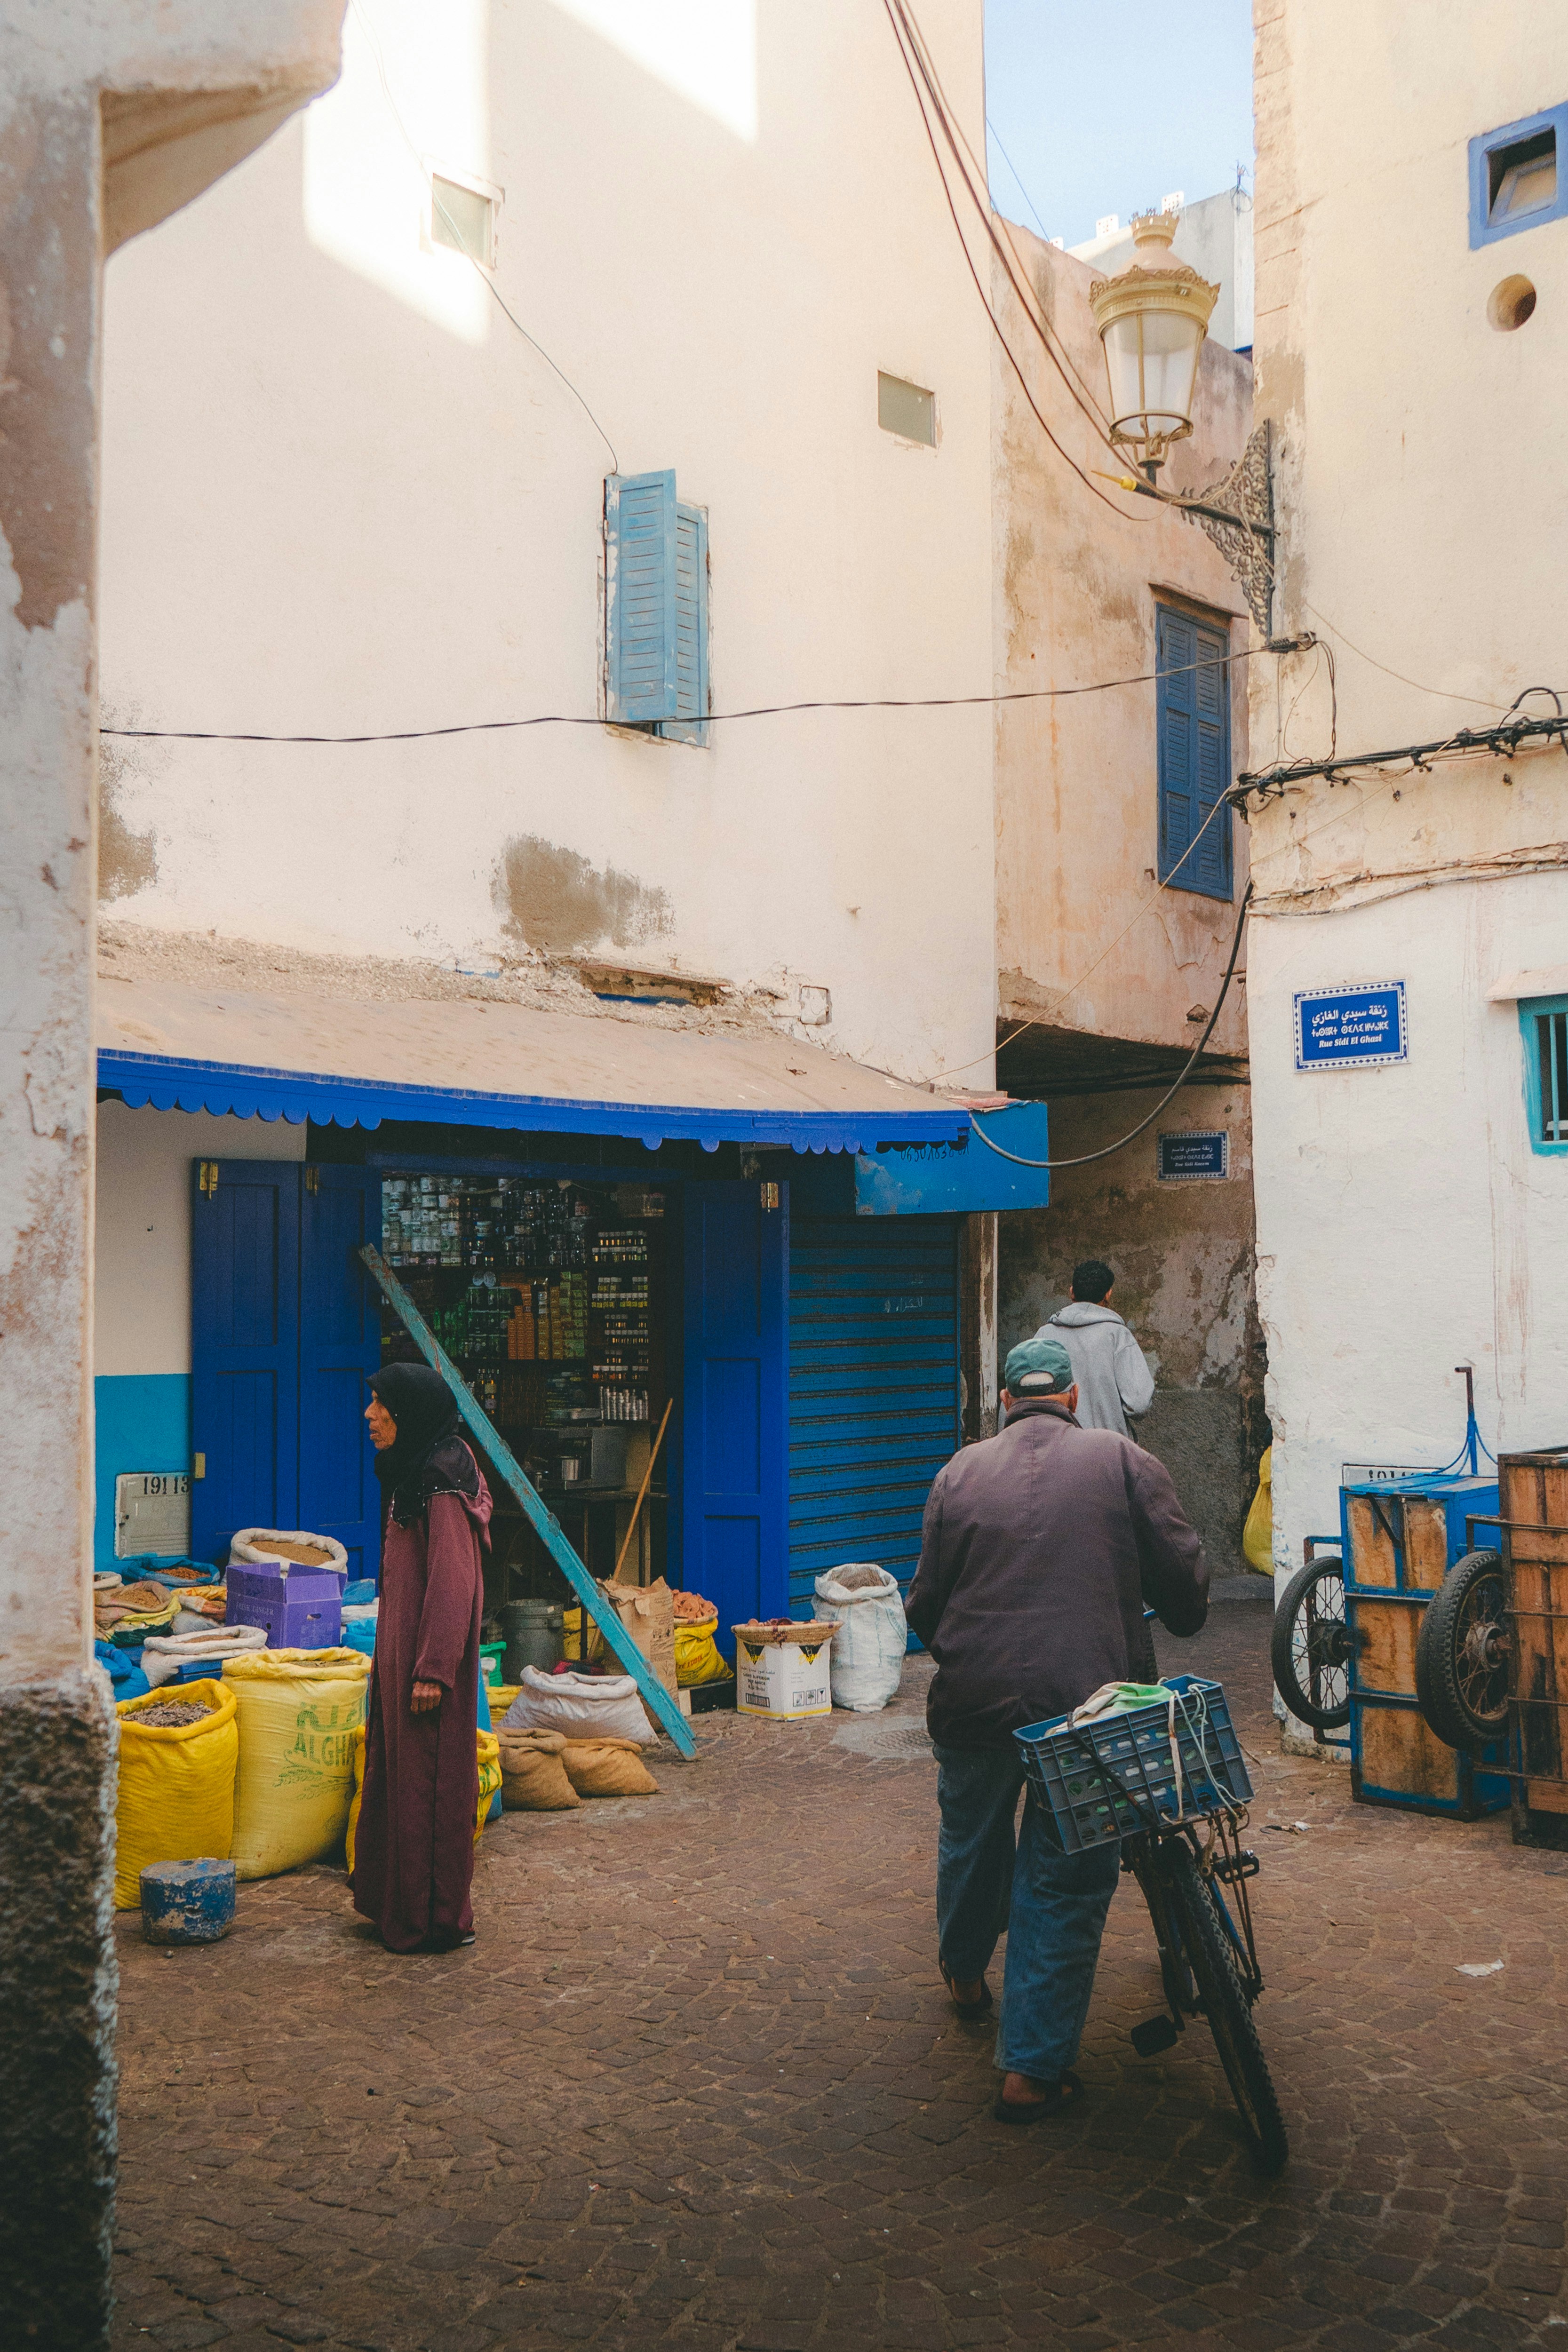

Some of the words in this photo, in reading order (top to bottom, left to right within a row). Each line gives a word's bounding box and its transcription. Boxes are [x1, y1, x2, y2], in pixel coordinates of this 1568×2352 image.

[1341, 1010, 1366, 1023] سيدي
[1369, 1005, 1387, 1017] زنقة
[1312, 1009, 1338, 1026] الغازي
[1335, 1037, 1348, 1046] Sidi
[1360, 1034, 1382, 1043] Ghazi
